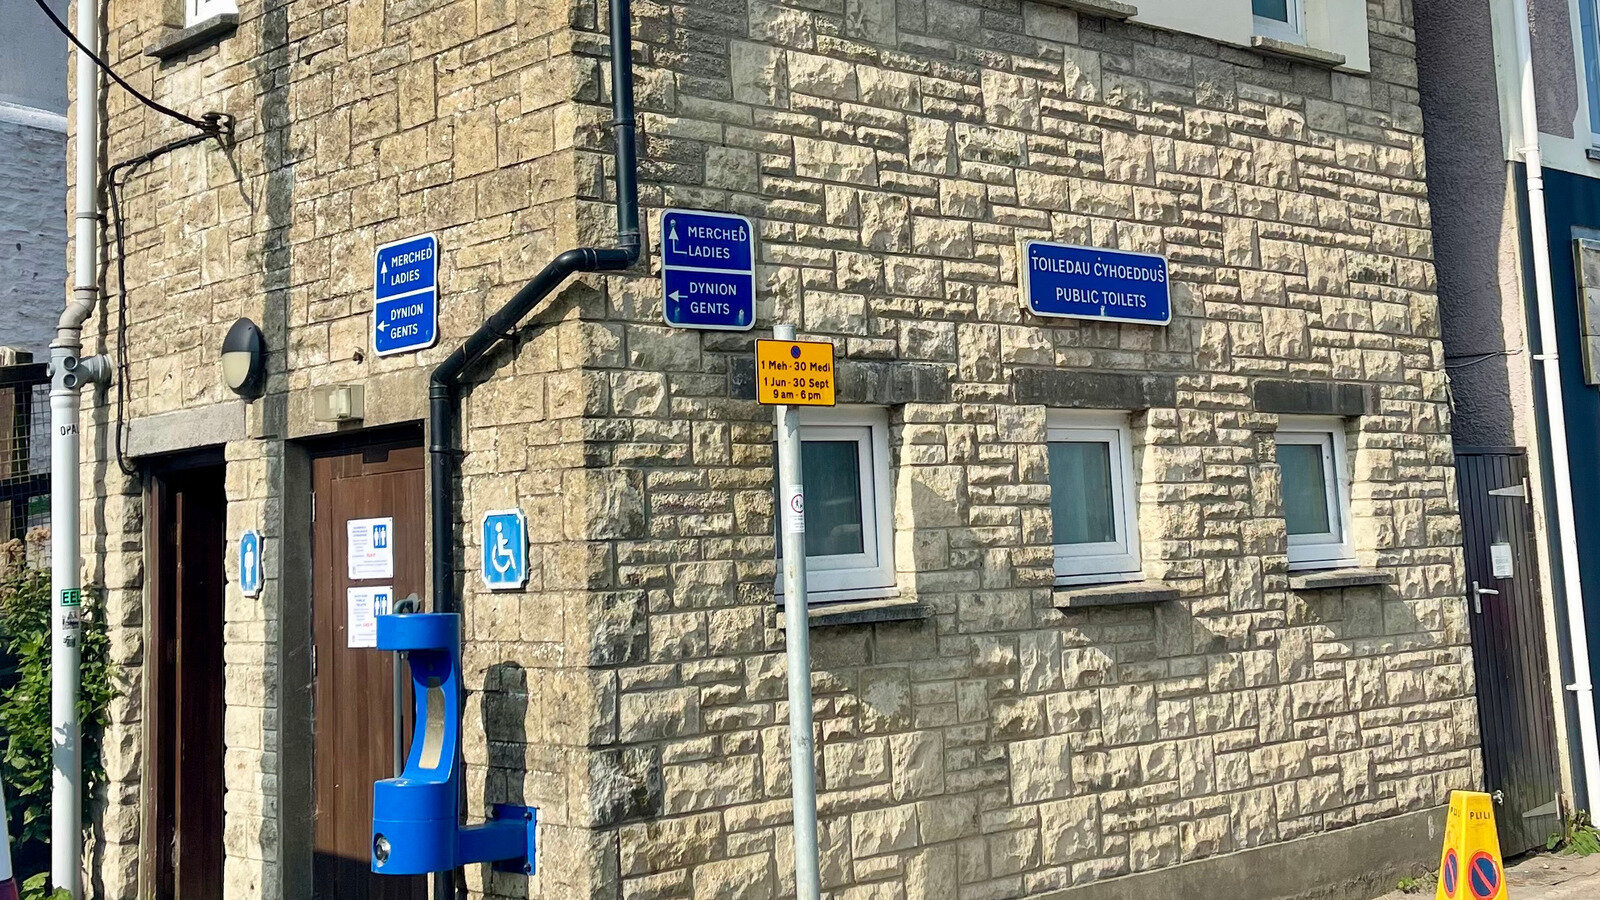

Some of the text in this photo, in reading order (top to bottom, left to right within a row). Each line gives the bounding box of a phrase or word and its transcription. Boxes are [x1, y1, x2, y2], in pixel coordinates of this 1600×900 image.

[688, 226, 747, 242] MERCHED
[391, 247, 433, 268] MERCHED
[688, 245, 730, 259] LADIES
[1031, 256, 1165, 282] TOILEDAU CYHOEDDUS
[390, 269, 420, 286] LADIES
[689, 281, 737, 296] DYNION
[1056, 287, 1147, 308] PUBLIC TOILETS
[390, 303, 424, 321] DYNION
[690, 301, 730, 315] GENTS
[390, 323, 418, 339] GENTS
[761, 360, 765, 370] 1
[768, 360, 788, 370] Meh
[794, 361, 807, 371] 30
[809, 362, 831, 372] Medi
[764, 377, 768, 386] 1
[771, 377, 787, 387] Jun
[793, 378, 806, 388] 30
[808, 378, 829, 390] Sept
